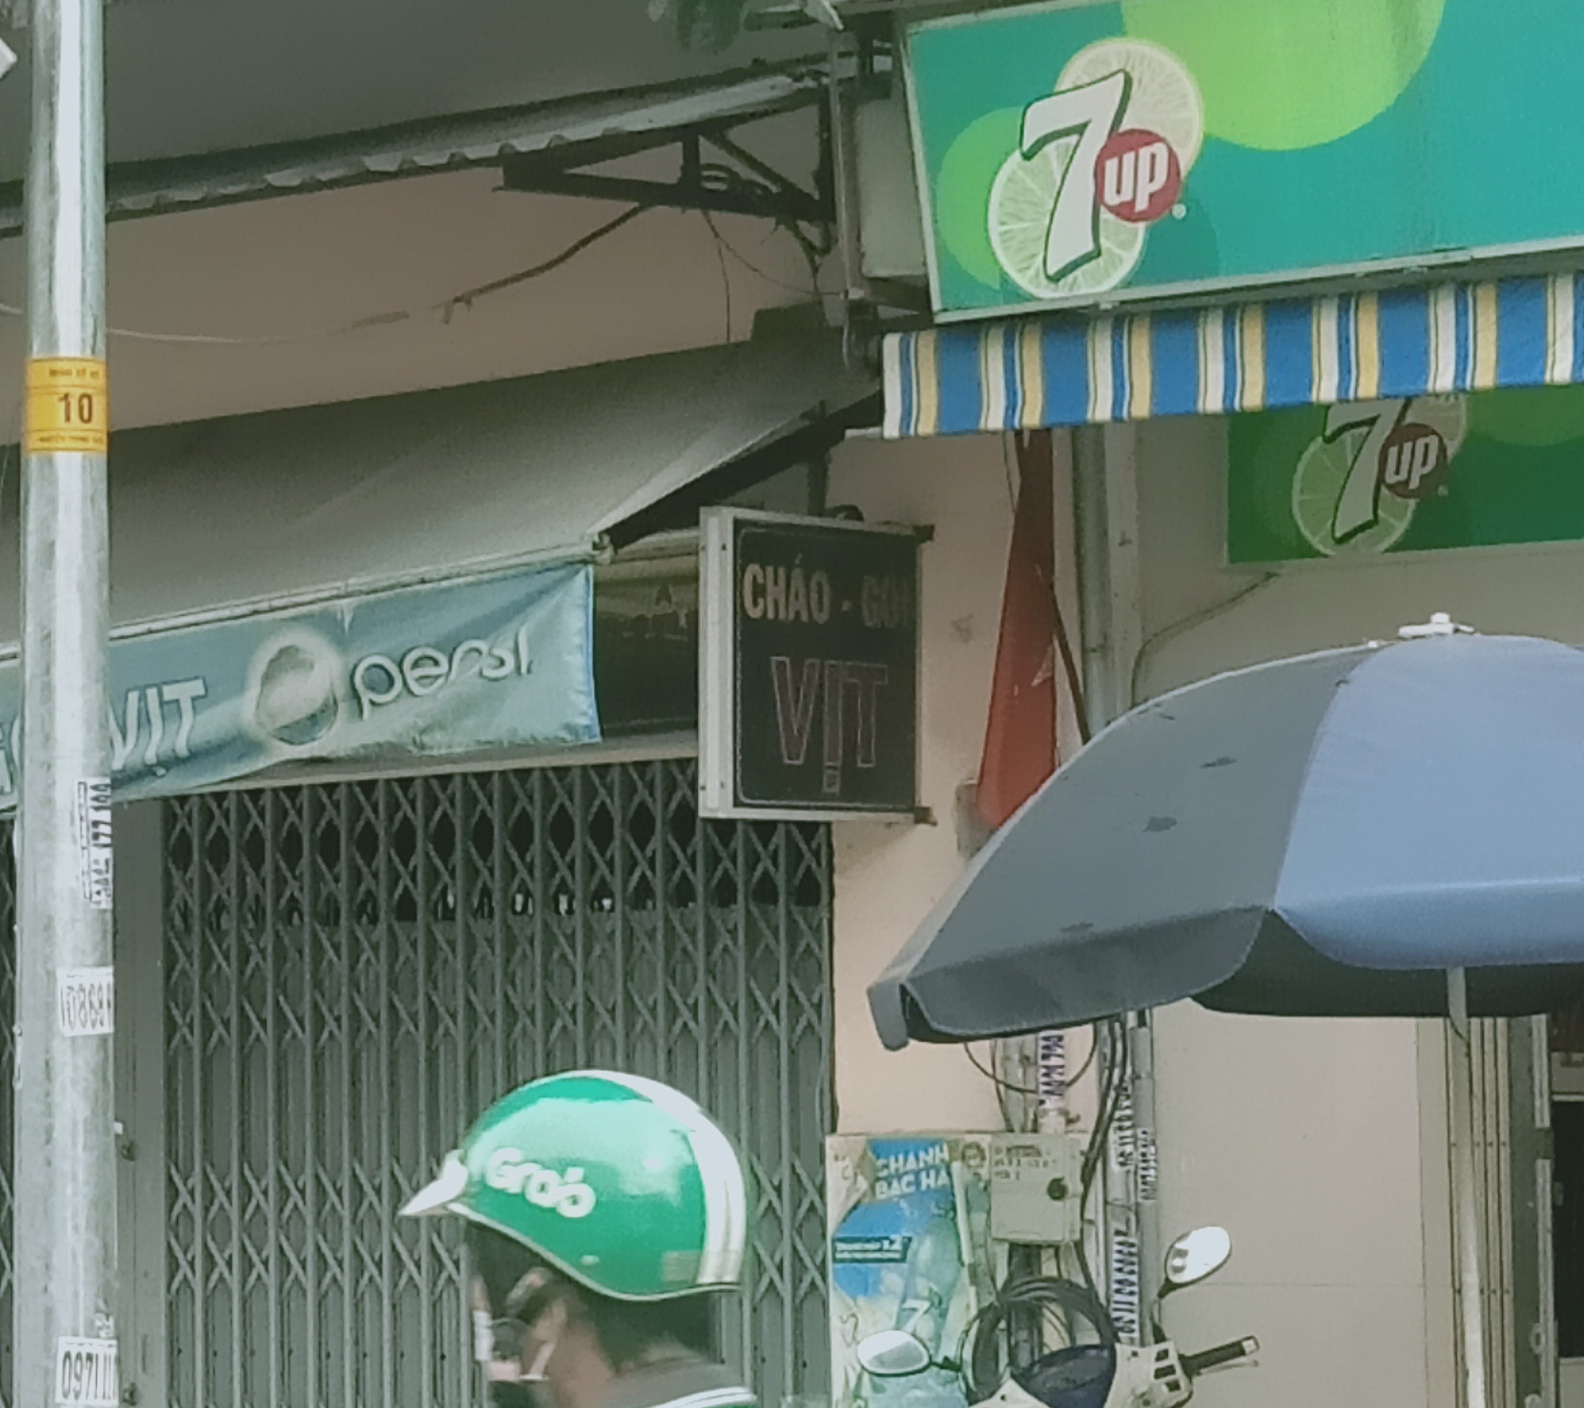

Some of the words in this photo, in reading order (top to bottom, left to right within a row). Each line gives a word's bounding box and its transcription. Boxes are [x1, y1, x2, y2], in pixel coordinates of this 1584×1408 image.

[58, 393, 93, 424] 10
[743, 552, 832, 625] CHÁO
[771, 656, 888, 793] VỊT
[485, 1146, 597, 1218] Grab
